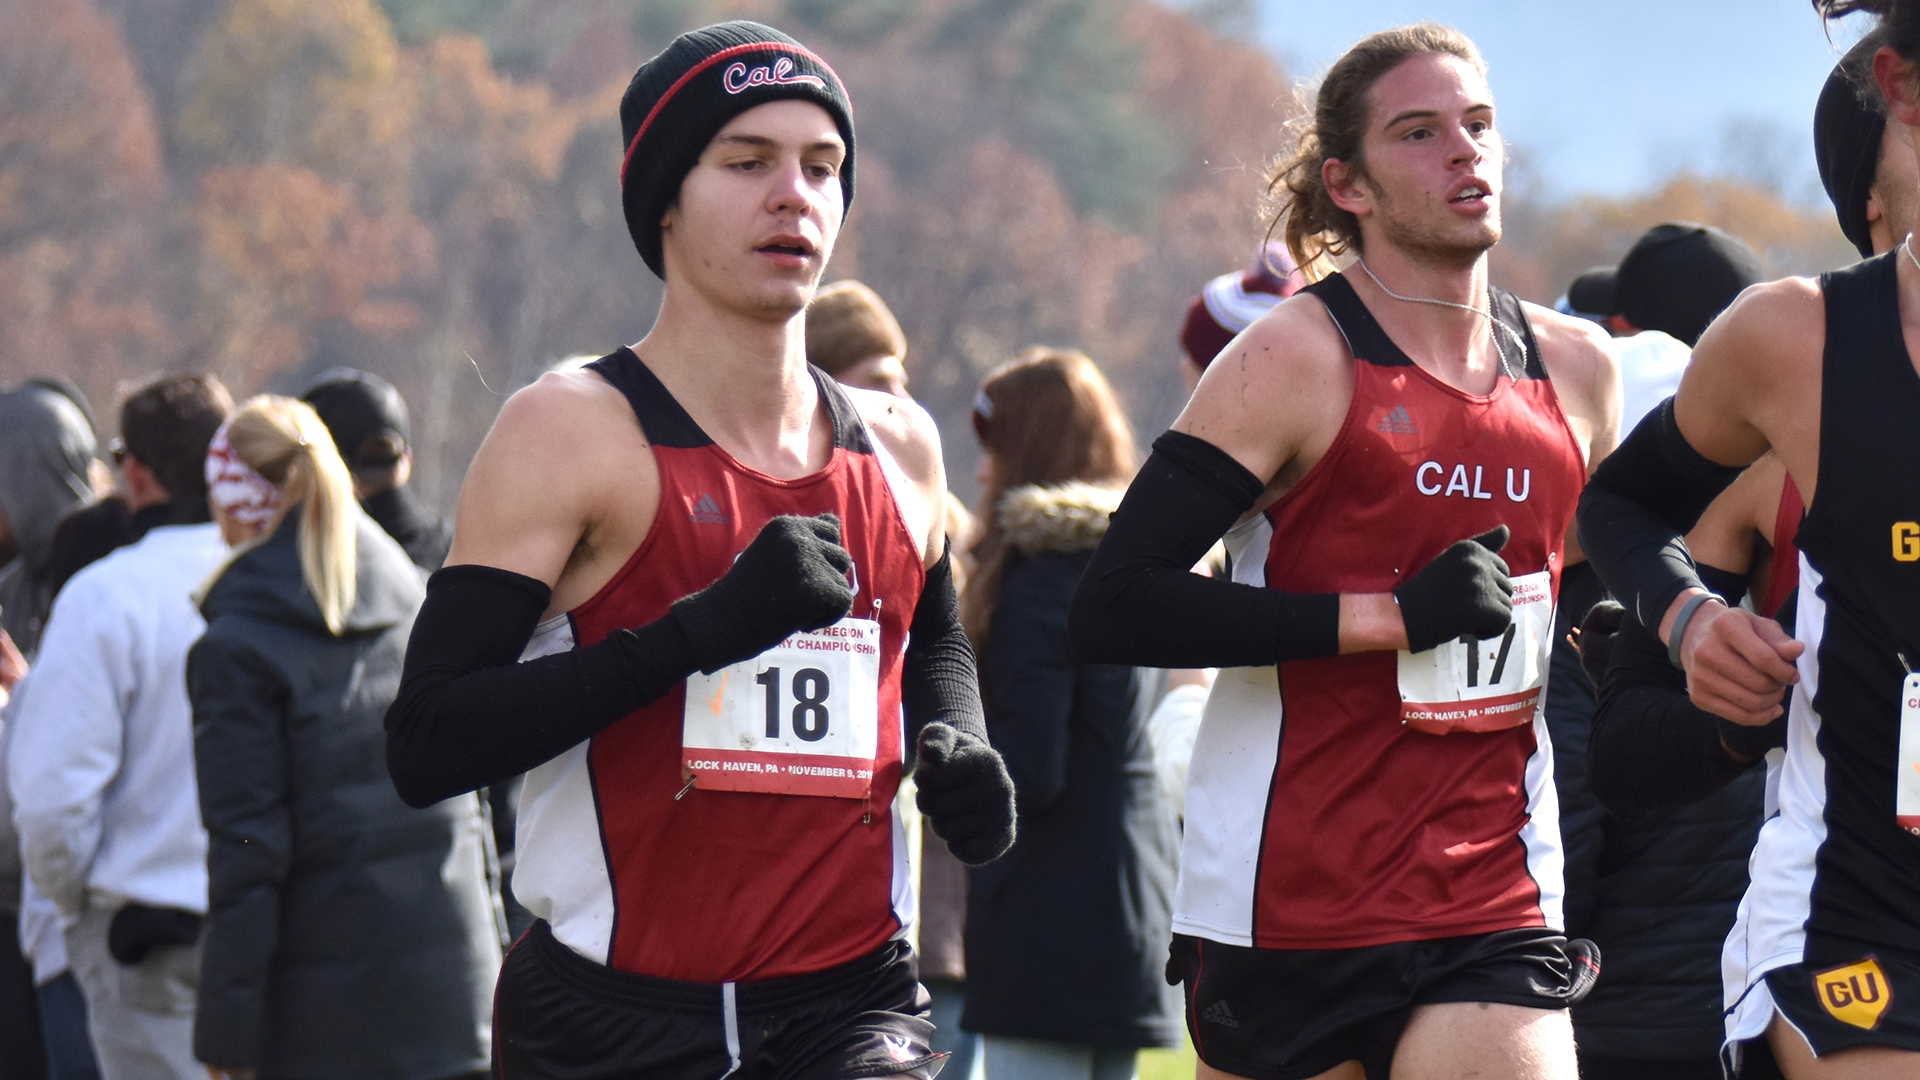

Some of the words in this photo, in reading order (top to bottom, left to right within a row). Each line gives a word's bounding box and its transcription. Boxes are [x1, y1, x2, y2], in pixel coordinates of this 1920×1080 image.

[723, 57, 826, 95] Cal
[1415, 461, 1492, 499] CAL
[1506, 468, 1530, 502] U
[823, 627, 864, 638] REGION
[1459, 623, 1516, 688] 17
[756, 666, 830, 742] 18
[1405, 711, 1433, 720] LOCK
[1468, 708, 1478, 717] PA
[687, 760, 720, 770] LOCK
[723, 761, 764, 774] HAVEN,
[765, 764, 779, 773] PA
[788, 765, 846, 778] NOVEMBER
[847, 769, 855, 780] 9,
[1825, 972, 1880, 1009] GU
